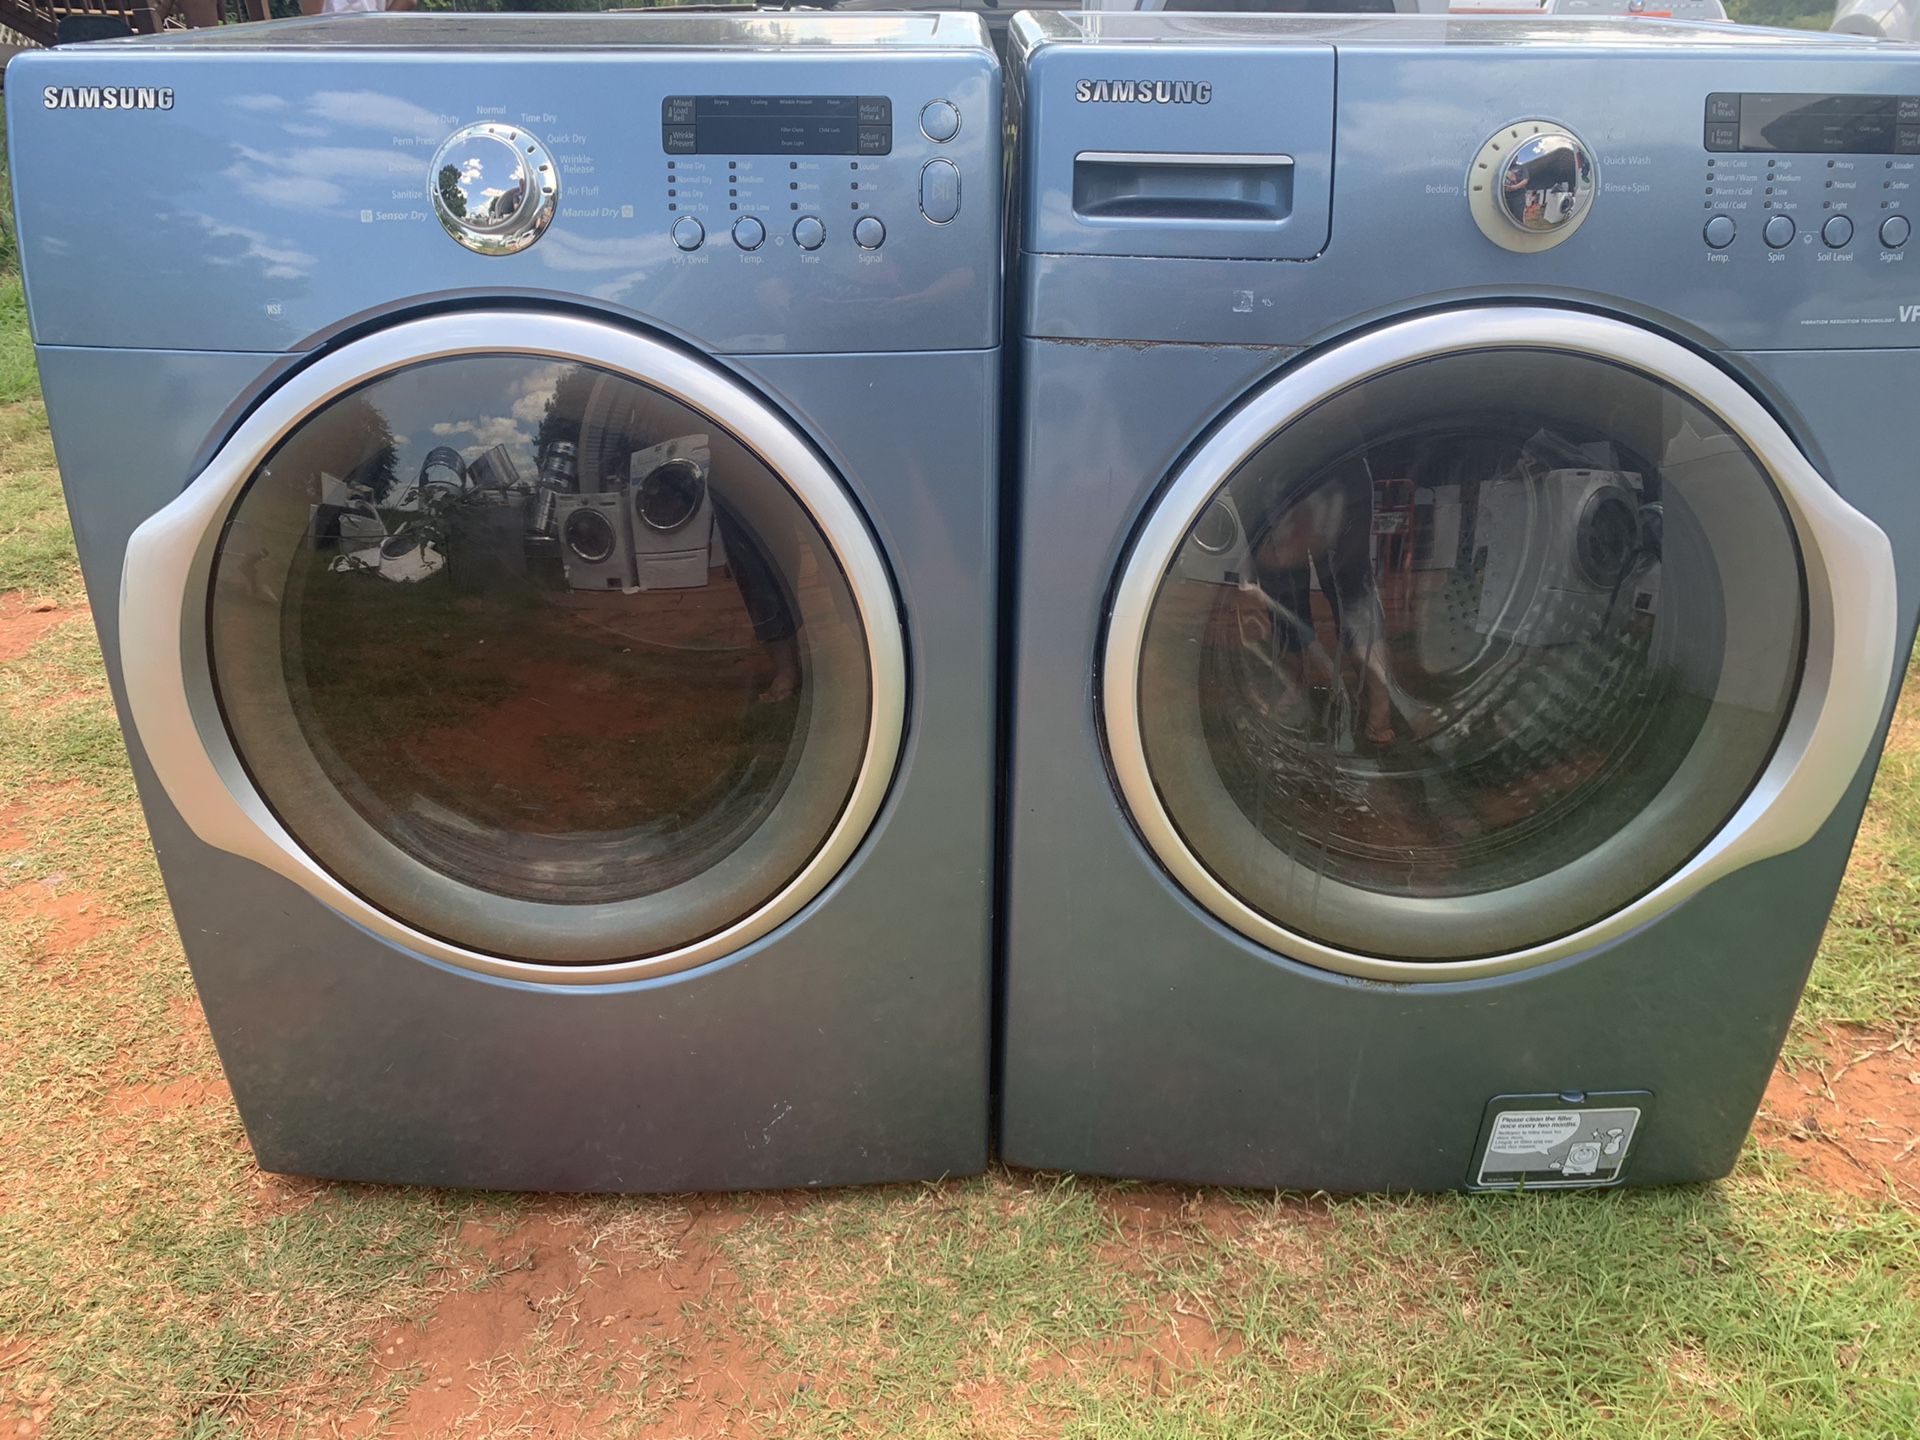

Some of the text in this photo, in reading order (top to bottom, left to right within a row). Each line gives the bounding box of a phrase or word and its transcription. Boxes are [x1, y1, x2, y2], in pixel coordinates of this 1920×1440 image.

[1076, 79, 1212, 103] SAMSUNG
[44, 86, 174, 109] SAMSUNG
[673, 98, 693, 107] Mixed
[476, 105, 507, 115] Normal
[673, 107, 689, 115] Load
[860, 103, 880, 113] Adjust
[440, 114, 460, 125] Duty
[521, 113, 558, 125] Time Dry
[547, 133, 588, 145] Quick Dry
[672, 130, 695, 139] Wrinkle
[860, 132, 880, 142] Adjust
[392, 136, 437, 146] Perm Press
[1603, 155, 1653, 166] Quick Wash
[1776, 160, 1792, 170] High
[1836, 160, 1855, 170] Heavy
[1893, 161, 1915, 170] Louder
[564, 164, 595, 174] Release
[1776, 173, 1801, 182] Medium
[1604, 183, 1651, 195] Rinse+Spin
[1833, 180, 1857, 189] Normal
[391, 189, 423, 200] Sanitize
[567, 185, 600, 196] Air Fluff
[1425, 184, 1459, 196] Bedding
[1774, 187, 1788, 196] Low
[1773, 201, 1798, 210] No Spin
[1832, 201, 1848, 211] Light
[1889, 201, 1900, 209] Off
[375, 210, 428, 222] Sensor Dry
[561, 207, 620, 219] Manual Dry
[686, 255, 709, 265] Level
[800, 254, 821, 264] Time
[858, 254, 883, 266] Signal
[1707, 252, 1731, 264] Temp.
[1768, 252, 1786, 264] Spin
[1817, 251, 1854, 262] Soil Level
[1879, 251, 1905, 264] Signal
